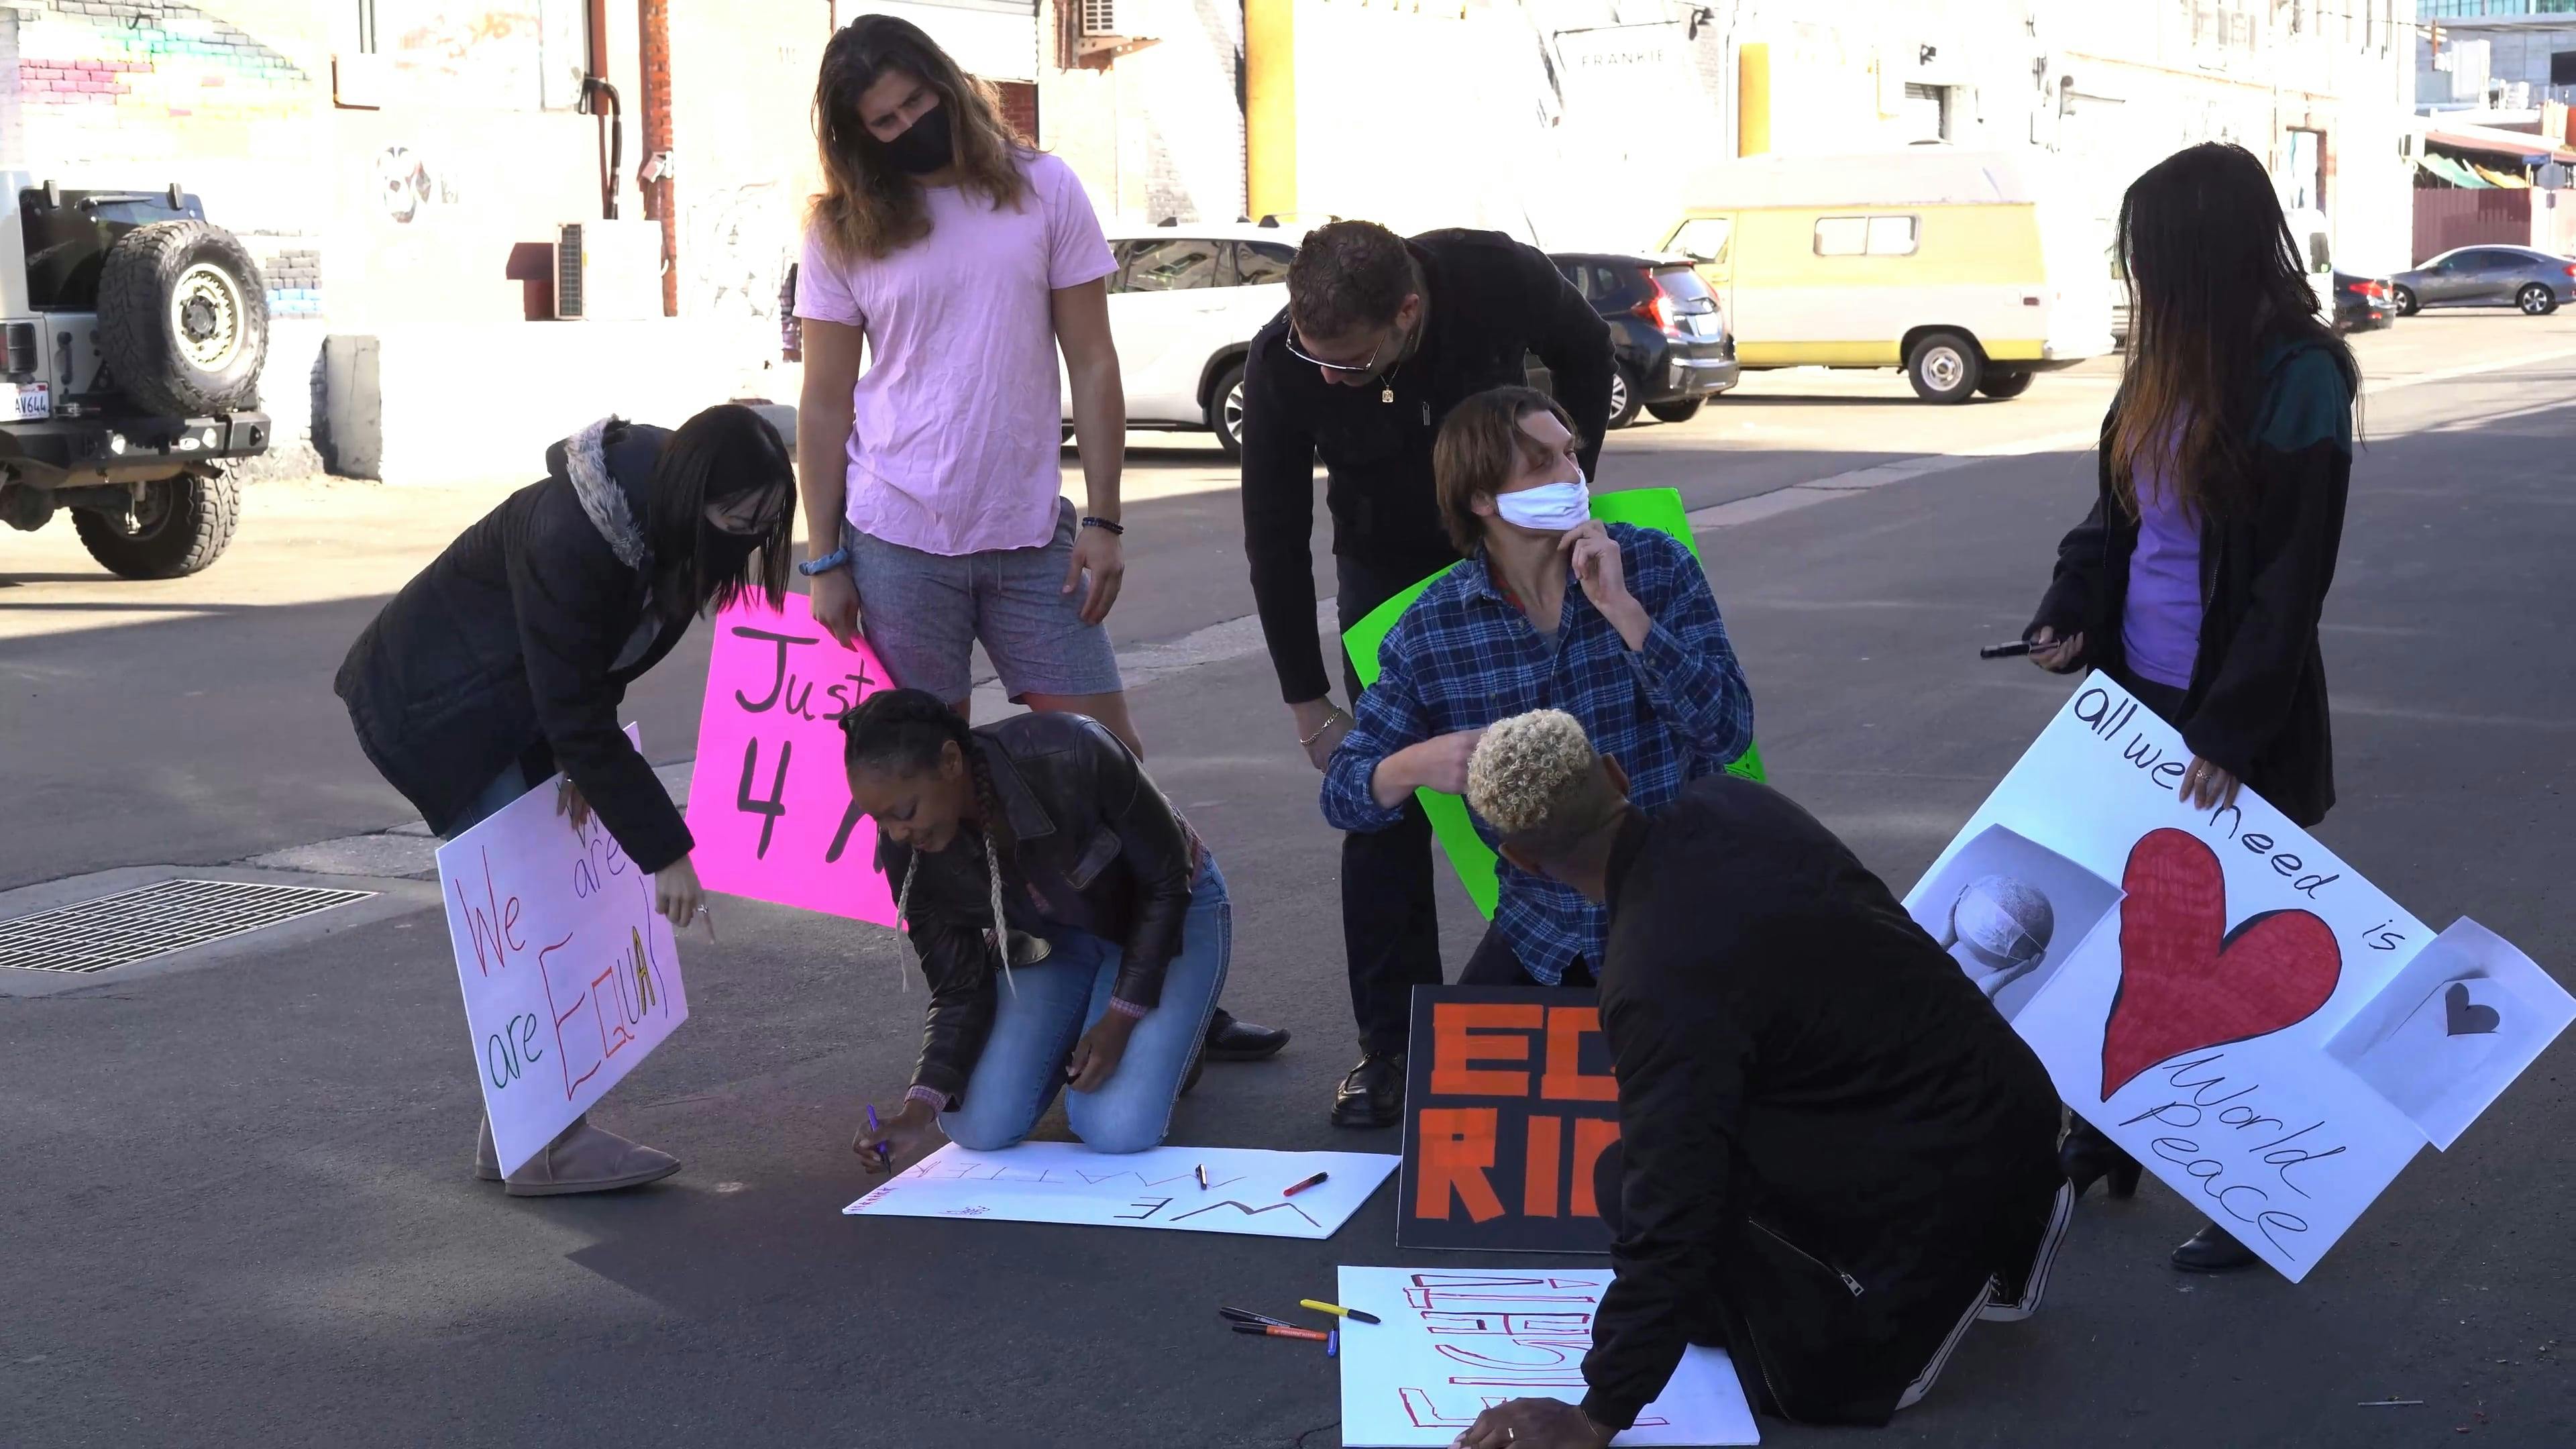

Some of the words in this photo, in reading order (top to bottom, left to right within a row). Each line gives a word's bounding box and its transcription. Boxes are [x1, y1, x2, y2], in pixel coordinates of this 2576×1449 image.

[1582, 48, 1664, 68] FRANKIE
[731, 626, 875, 721] Just
[737, 736, 792, 861] 4
[2125, 732, 2187, 790] we
[2210, 804, 2341, 900] need
[2361, 918, 2406, 953] is
[455, 845, 526, 977] We
[574, 835, 626, 898] are
[488, 1012, 543, 1089] are
[1415, 1108, 1621, 1223] RI
[2161, 1054, 2347, 1199] World
[1113, 1196, 1322, 1228] WE
